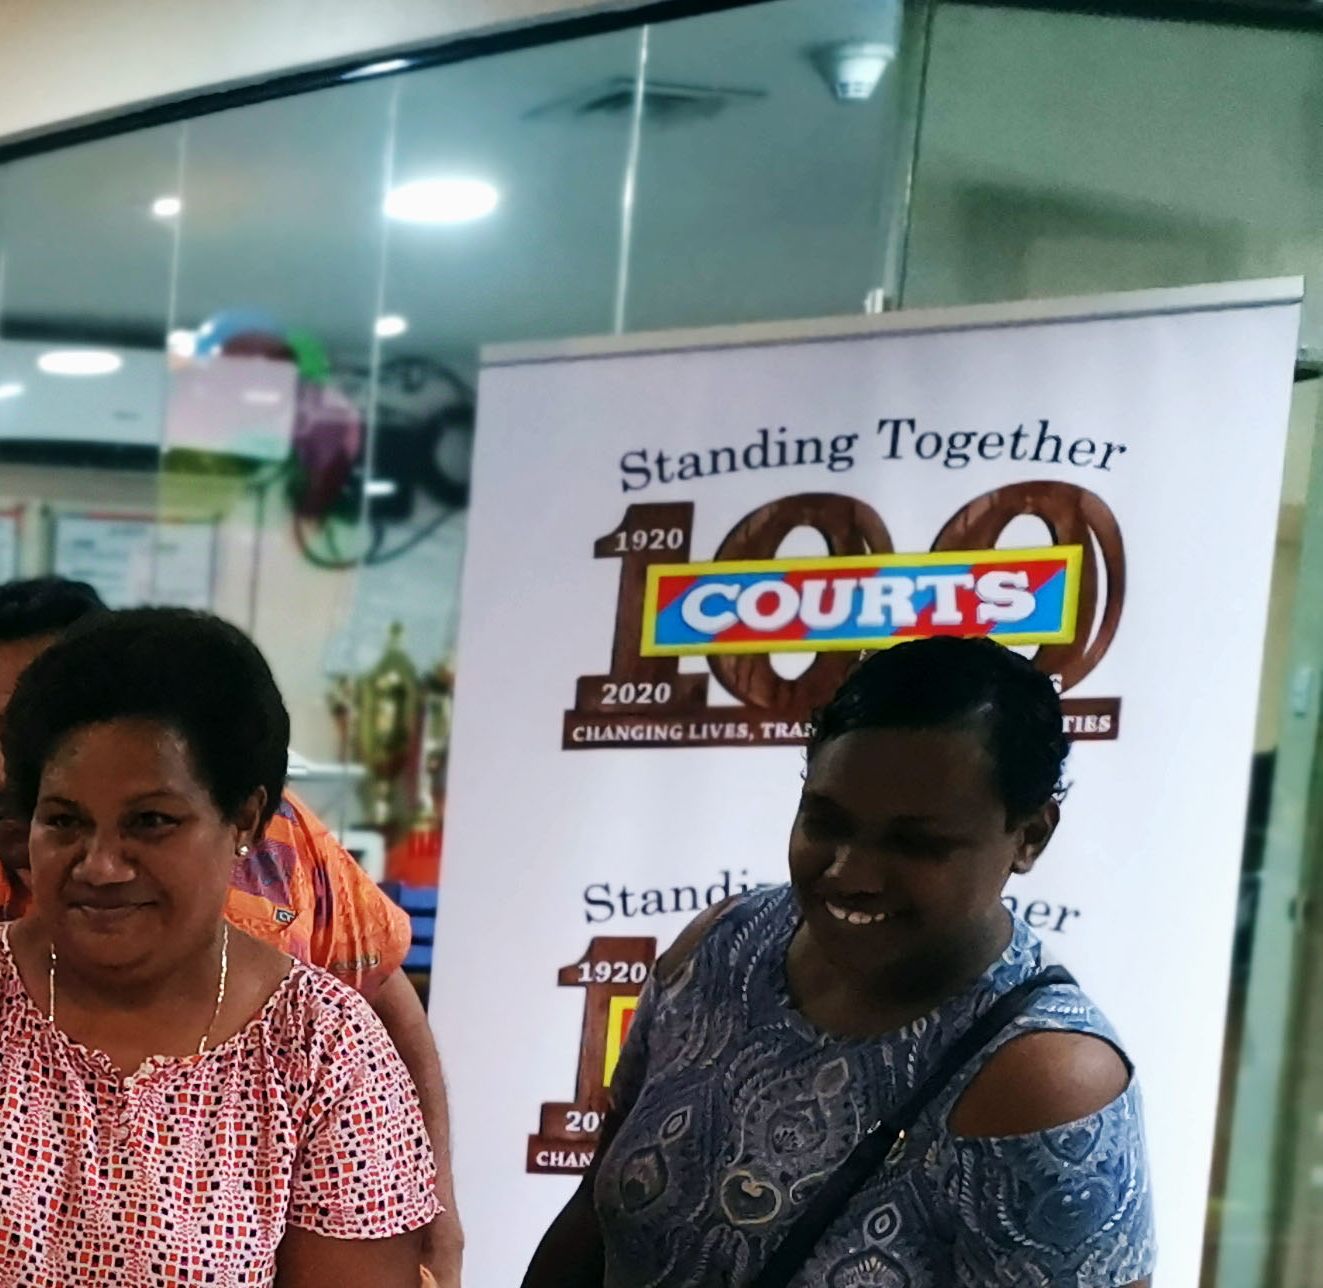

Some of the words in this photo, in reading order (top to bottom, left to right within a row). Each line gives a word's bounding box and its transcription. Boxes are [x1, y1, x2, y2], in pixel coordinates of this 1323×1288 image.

[619, 426, 859, 494] Standing
[877, 417, 1127, 473] Together
[613, 528, 684, 552] 1920
[681, 569, 1038, 634] COURTS
[600, 682, 672, 707] 2020
[572, 722, 683, 743] CHANGING
[689, 721, 755, 741] LIVES,
[577, 960, 647, 985] 1920
